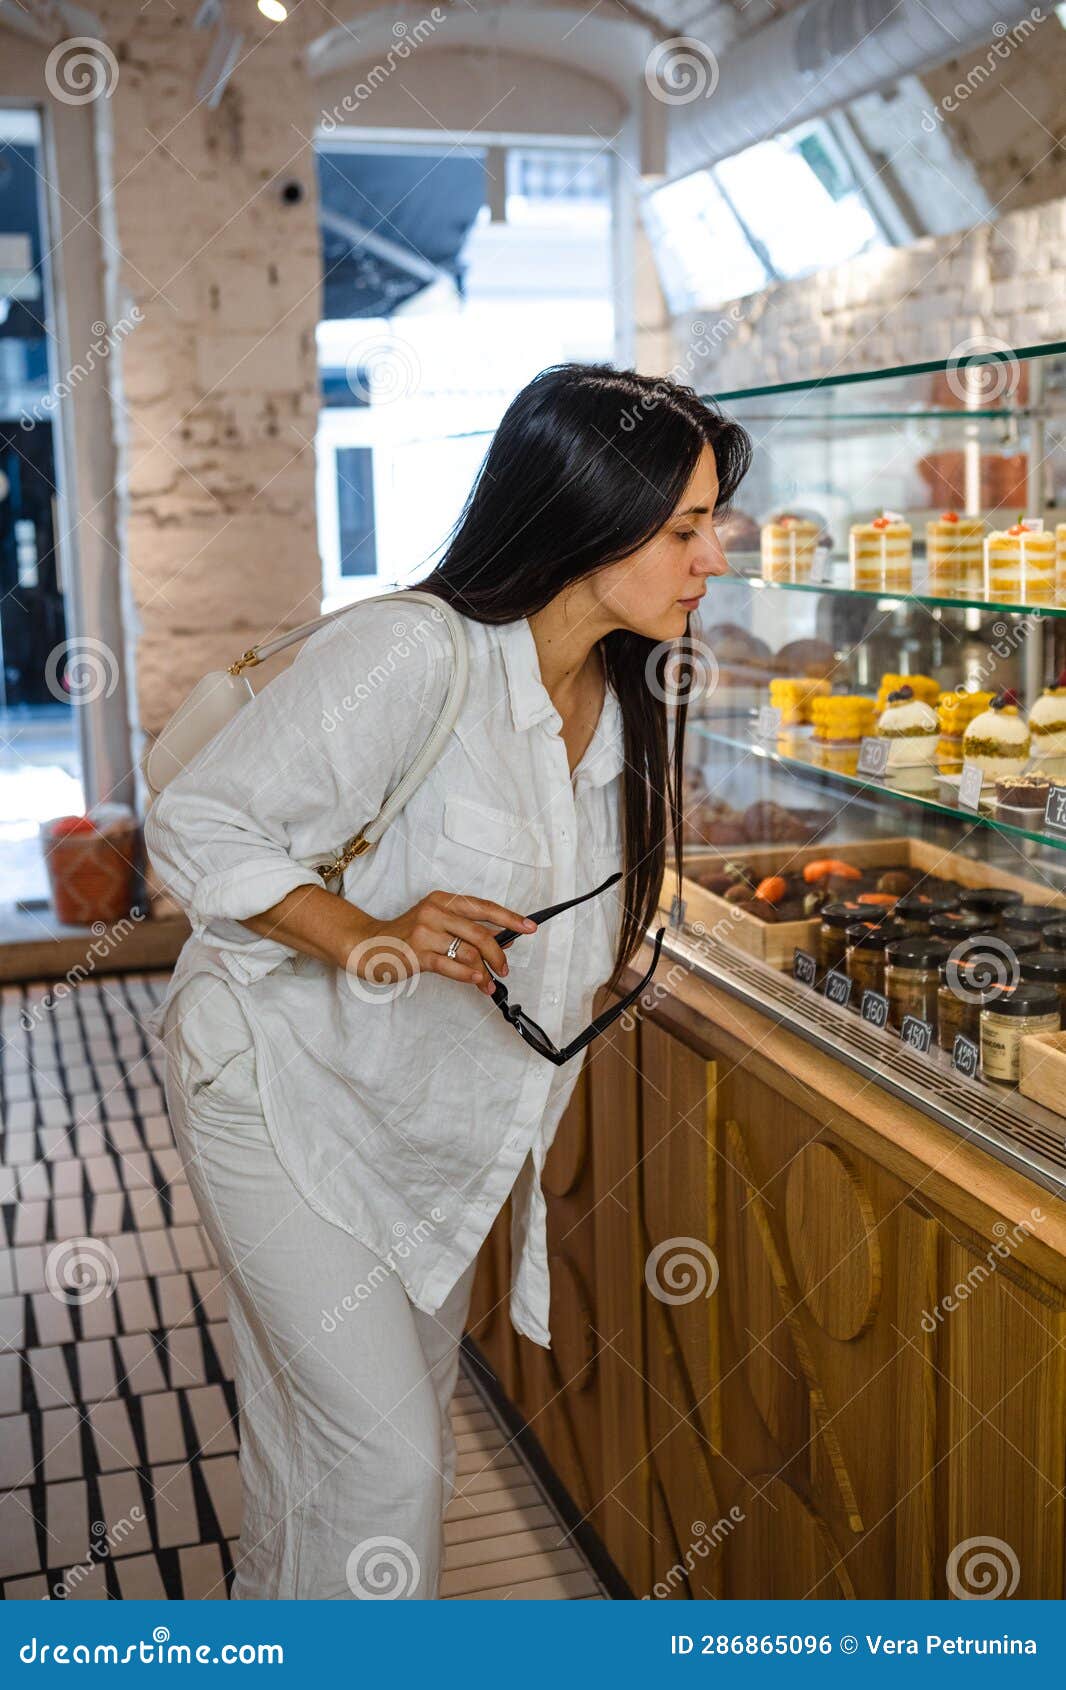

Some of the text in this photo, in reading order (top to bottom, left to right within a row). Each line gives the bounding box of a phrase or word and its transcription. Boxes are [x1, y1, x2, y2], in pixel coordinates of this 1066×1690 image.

[865, 999, 884, 1024] 160
[906, 1023, 926, 1050] 150
[957, 1044, 972, 1070] 125
